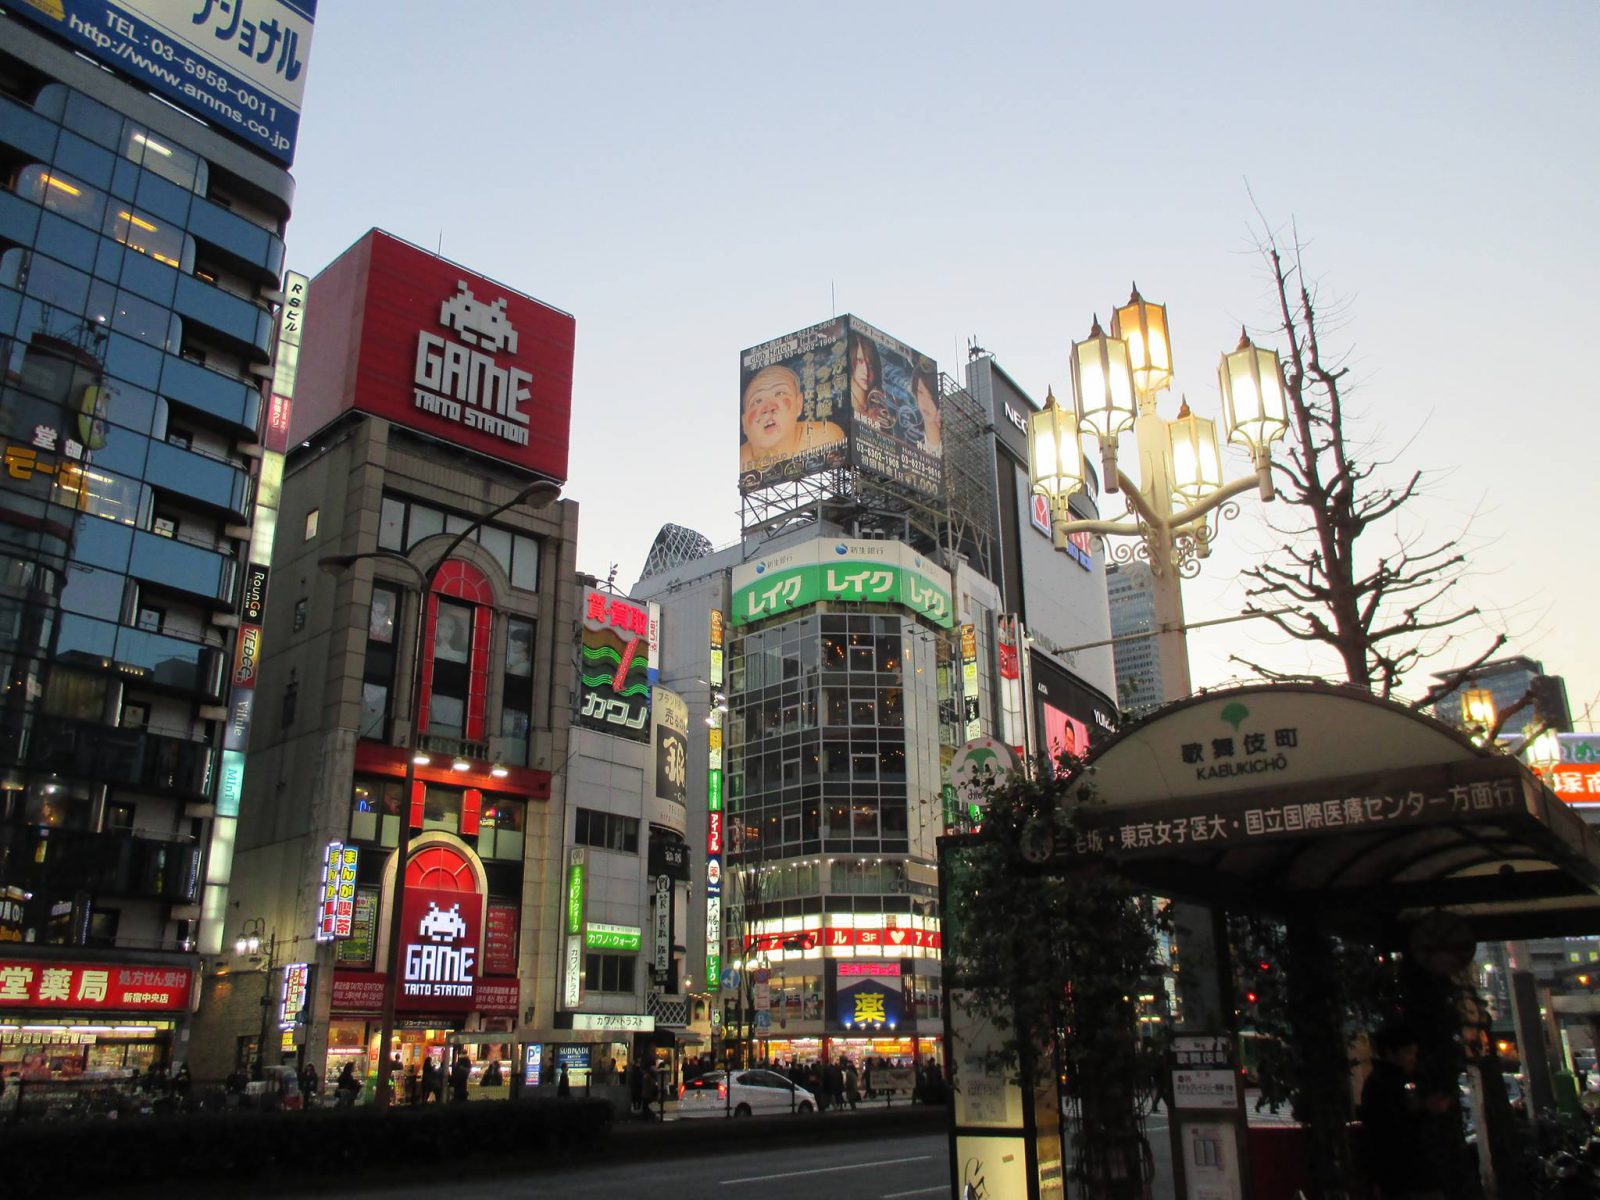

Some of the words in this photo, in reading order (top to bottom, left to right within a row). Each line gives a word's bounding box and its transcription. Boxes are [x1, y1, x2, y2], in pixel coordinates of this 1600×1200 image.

[68, 13, 290, 150] http://www.amms.co.jp
[414, 329, 533, 424] GAME
[414, 386, 461, 422] TAITO
[464, 406, 529, 447] STATION
[850, 546, 884, 555] 新生銀行
[749, 575, 802, 616] レイク
[827, 569, 893, 593] レイク
[910, 576, 945, 616] レイク
[582, 692, 647, 730] カワノ
[1181, 727, 1298, 764] 歌舞伎町
[710, 813, 719, 851] アイフル
[335, 848, 357, 935] まんが喫茶
[588, 934, 638, 947] カワノ・クォーク
[862, 932, 877, 942] 3F
[119, 970, 187, 988] 処方せん受付
[404, 944, 475, 982] GAME
[123, 993, 169, 1004] 新宿中央店
[404, 983, 431, 995] TAITO
[433, 984, 472, 996] STATION
[596, 1015, 644, 1026] カワノ・トラスト
